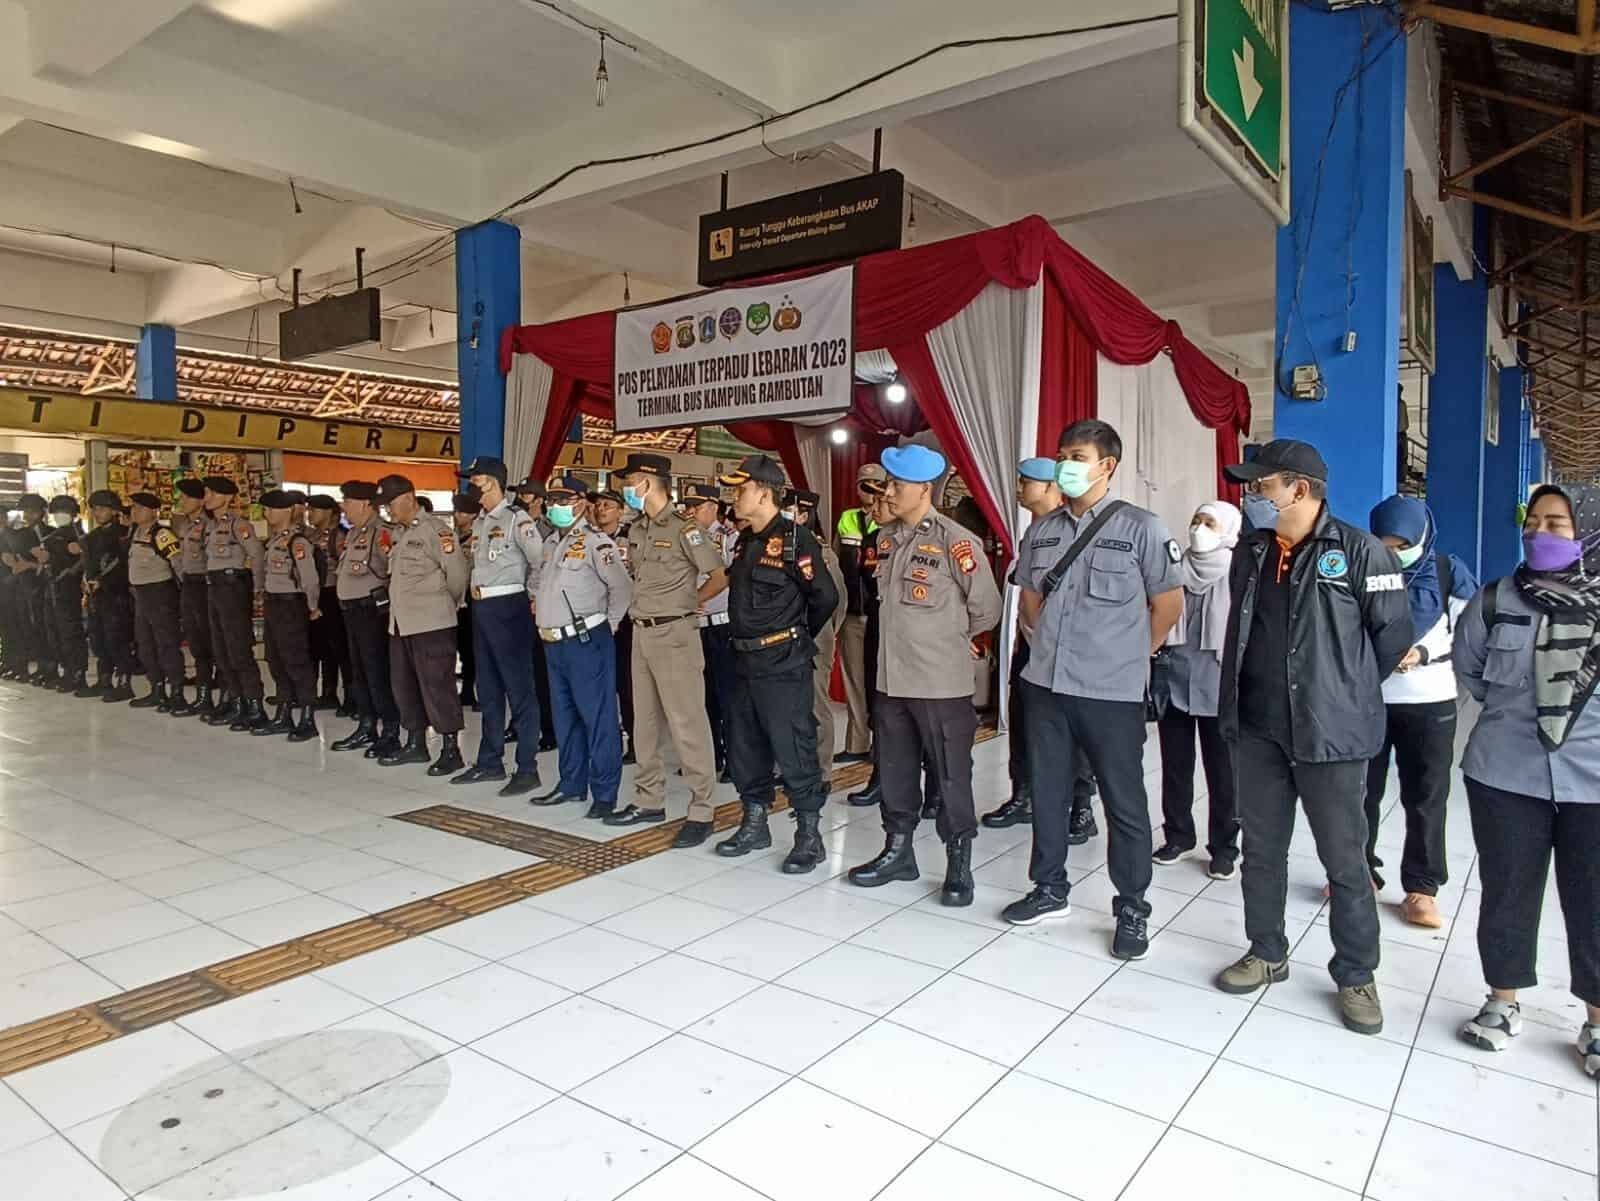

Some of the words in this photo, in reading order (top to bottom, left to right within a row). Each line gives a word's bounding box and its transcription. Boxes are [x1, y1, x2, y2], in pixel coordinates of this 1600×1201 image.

[840, 205, 855, 216] Bus
[856, 198, 879, 213] AKAP
[618, 370, 638, 396] POS
[640, 361, 696, 393] PELAYANAN
[698, 353, 750, 385] TERPADU
[752, 343, 808, 377] LEBARAN
[811, 338, 847, 369] 2023
[637, 389, 682, 417] TERMINAL
[683, 387, 702, 412] BUS
[704, 383, 756, 409] KAMPUNG
[759, 375, 823, 402] RAMBUTAN
[911, 554, 940, 569] POLRI
